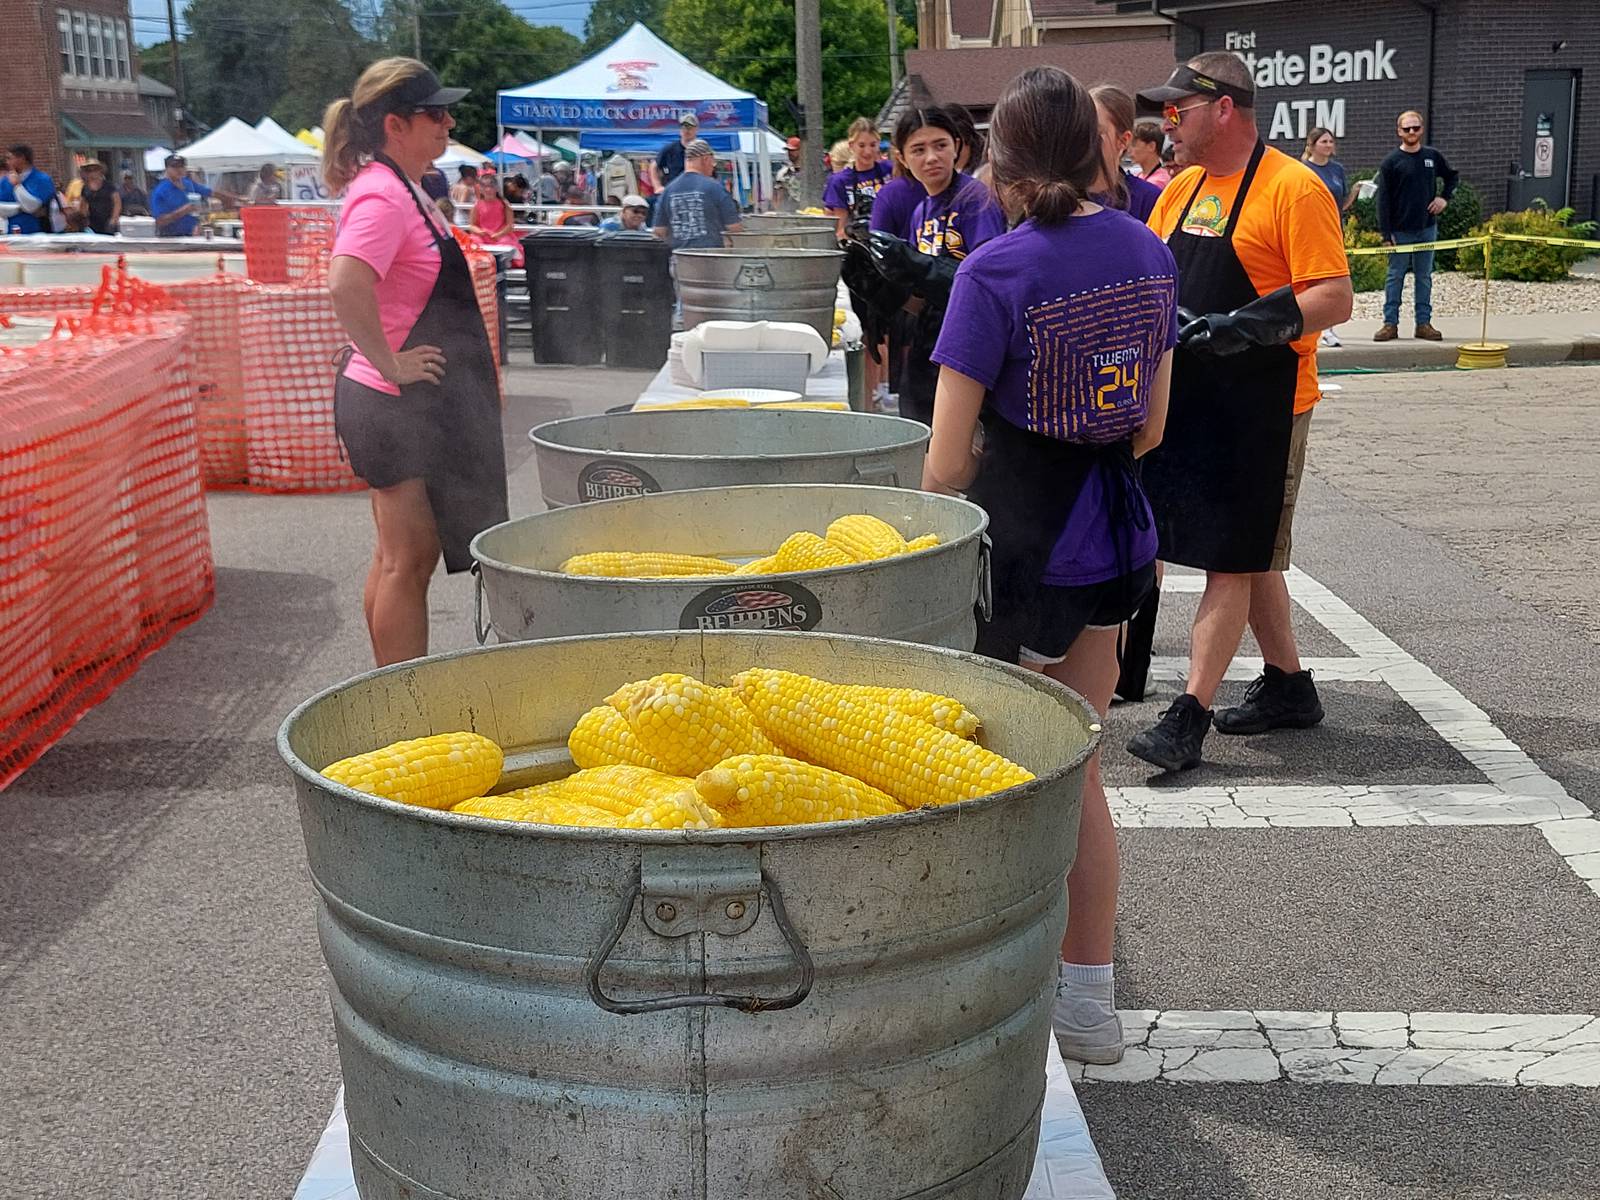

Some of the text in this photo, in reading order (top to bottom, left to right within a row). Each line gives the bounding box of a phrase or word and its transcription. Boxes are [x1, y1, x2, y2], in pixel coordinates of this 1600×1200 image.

[1225, 30, 1256, 50] First
[1236, 39, 1397, 88] tate Bank
[511, 103, 581, 119] STARVED
[584, 106, 626, 120] ROCK
[1268, 98, 1345, 140] ATM
[1092, 346, 1140, 368] TWENTY
[1097, 360, 1139, 411] 24
